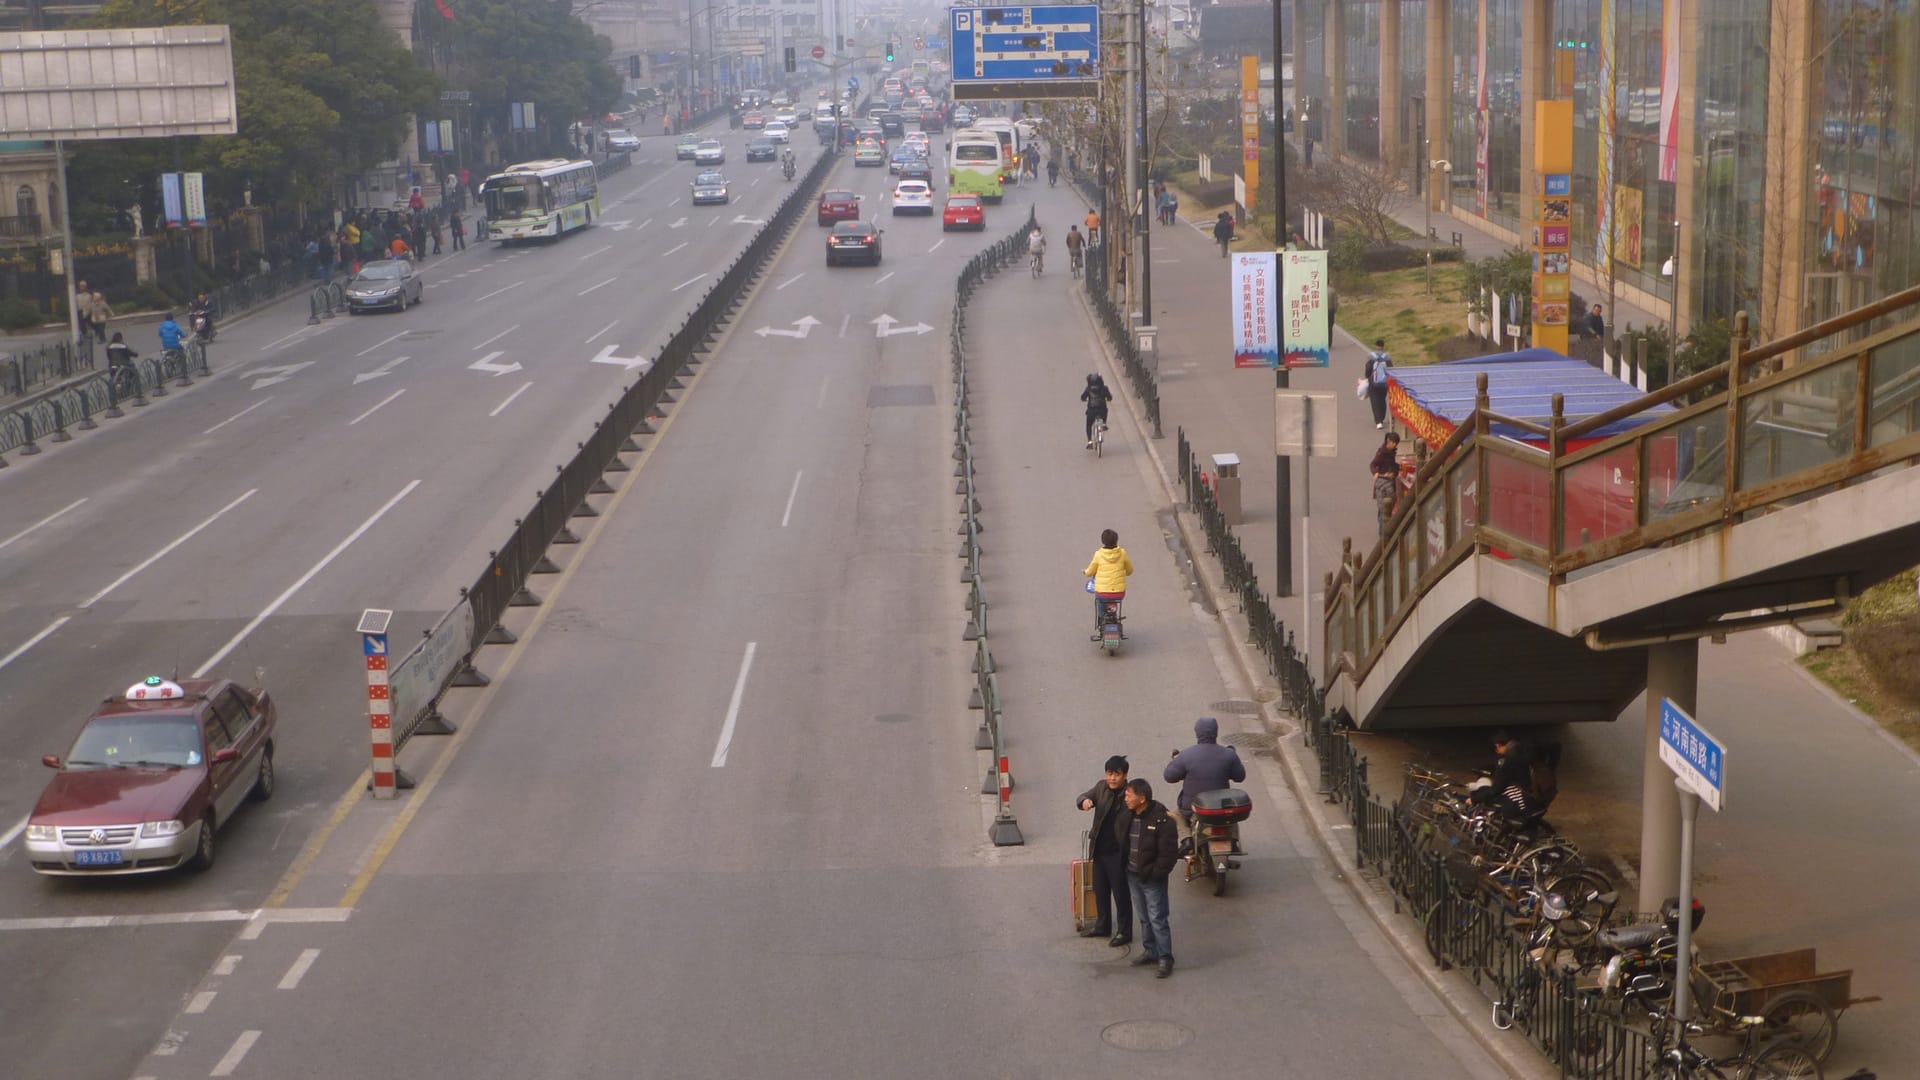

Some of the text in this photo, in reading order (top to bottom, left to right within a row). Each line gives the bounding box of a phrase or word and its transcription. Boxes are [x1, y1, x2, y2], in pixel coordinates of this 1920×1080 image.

[958, 14, 969, 29] P
[1256, 268, 1267, 344] 文明城区你我同创
[1301, 284, 1311, 322] 奉献他人
[1310, 270, 1320, 309] 学习雷锋
[1291, 300, 1301, 338] 提升自己
[1672, 717, 1707, 771] 河南南路
